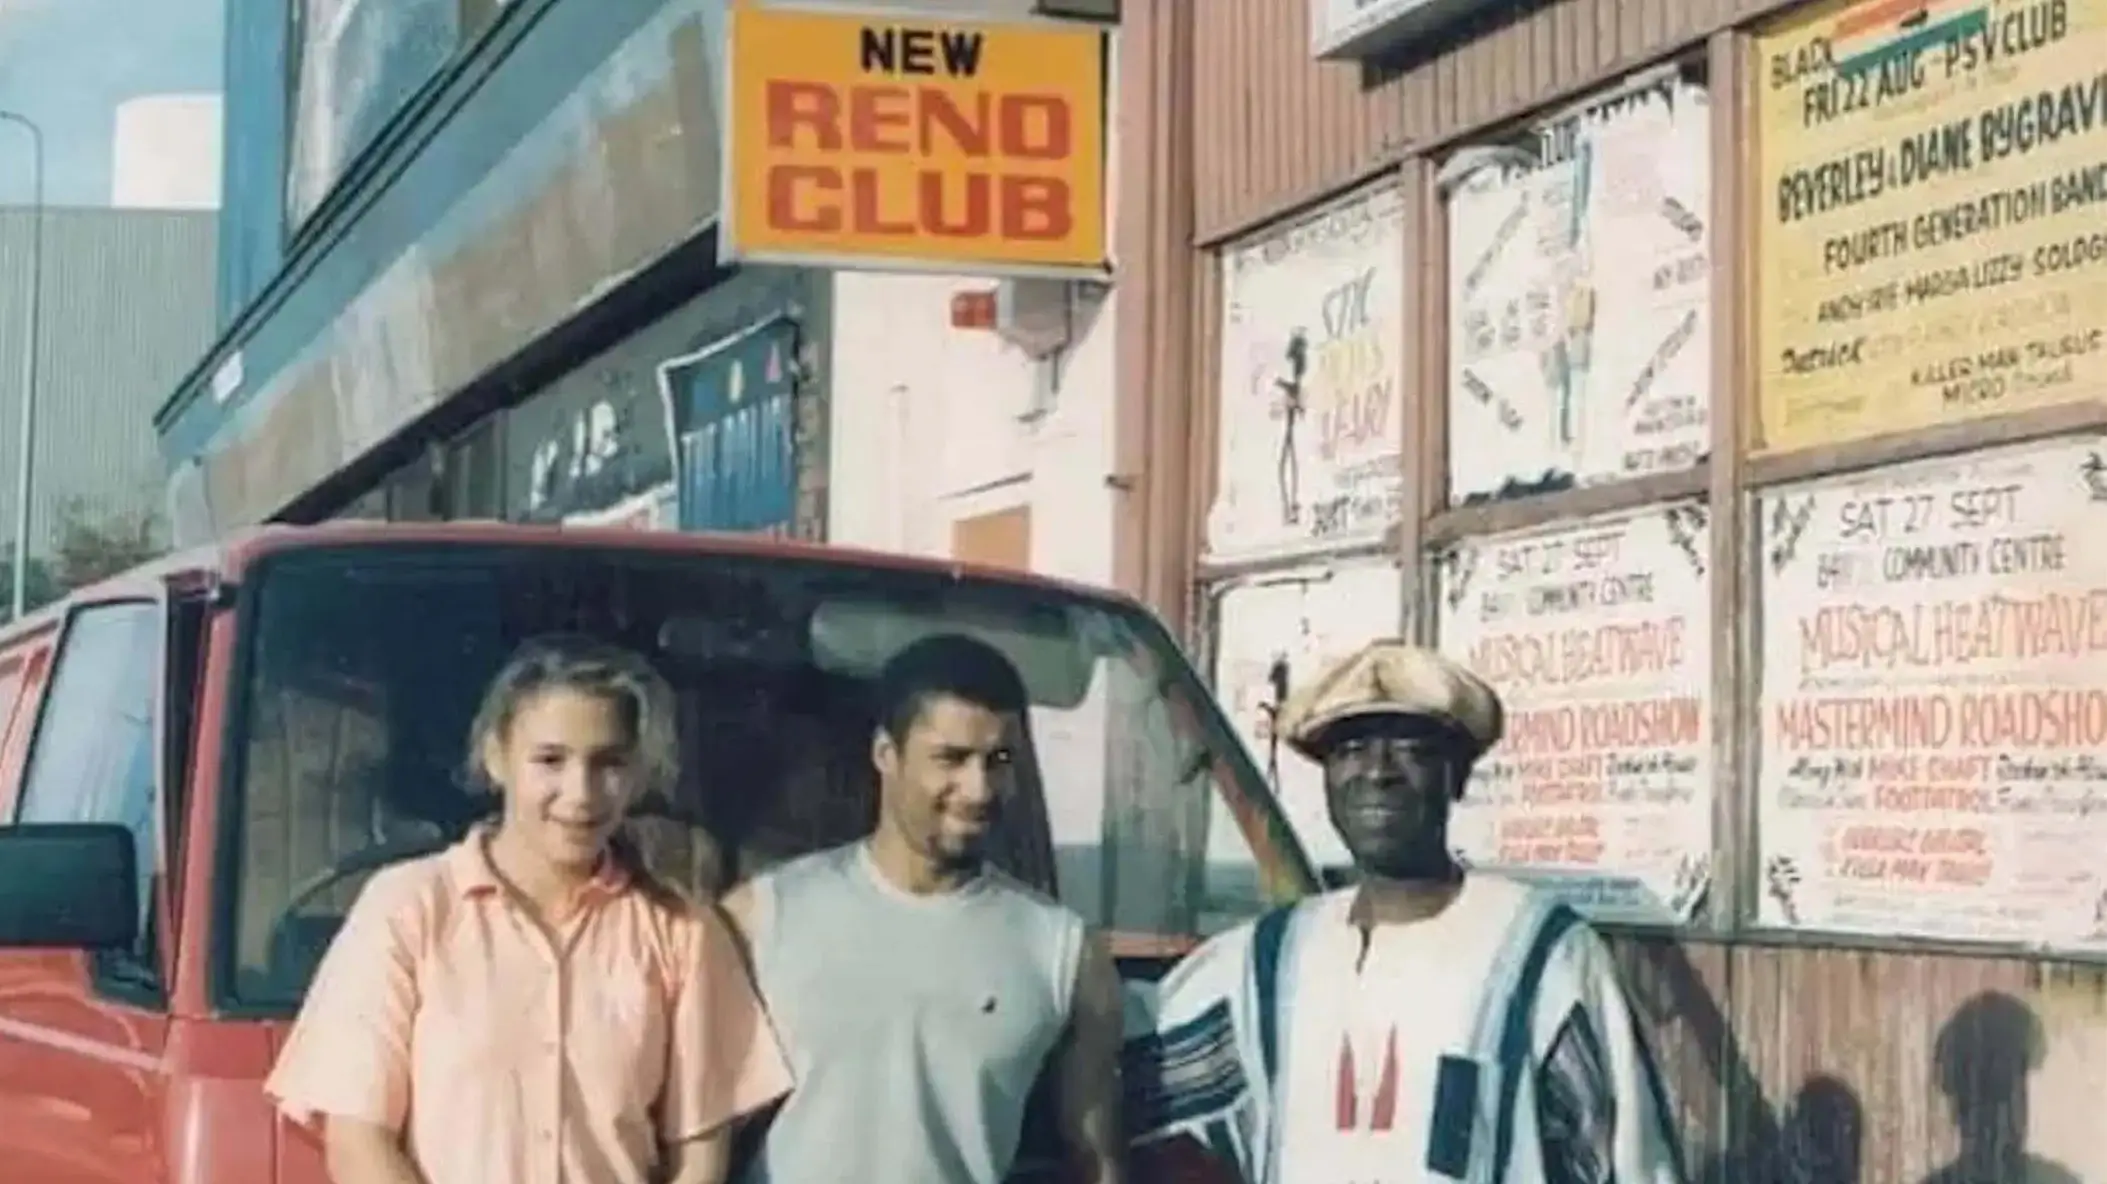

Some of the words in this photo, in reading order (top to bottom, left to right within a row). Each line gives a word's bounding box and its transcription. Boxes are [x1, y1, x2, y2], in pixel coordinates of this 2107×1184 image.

[861, 27, 985, 76] NEW
[1803, 80, 1839, 128] FRI
[1876, 48, 1925, 107] AUG
[766, 79, 1072, 160] RENO
[767, 164, 1073, 241] CLUB
[1778, 147, 1884, 222] BEVERLEY
[1900, 118, 1973, 187] DIANE
[1824, 220, 1908, 274] FOURTH
[1913, 181, 2046, 250] GENERATION
[1840, 497, 1895, 538] SAT
[1904, 494, 1935, 533] 27
[1949, 483, 2025, 529] SEPT
[1883, 541, 1980, 583] COMMUNITY
[1988, 533, 2067, 576] CENTRE
[1799, 603, 1930, 673] MUSICAL
[1776, 695, 1952, 752] MASTERMIND
